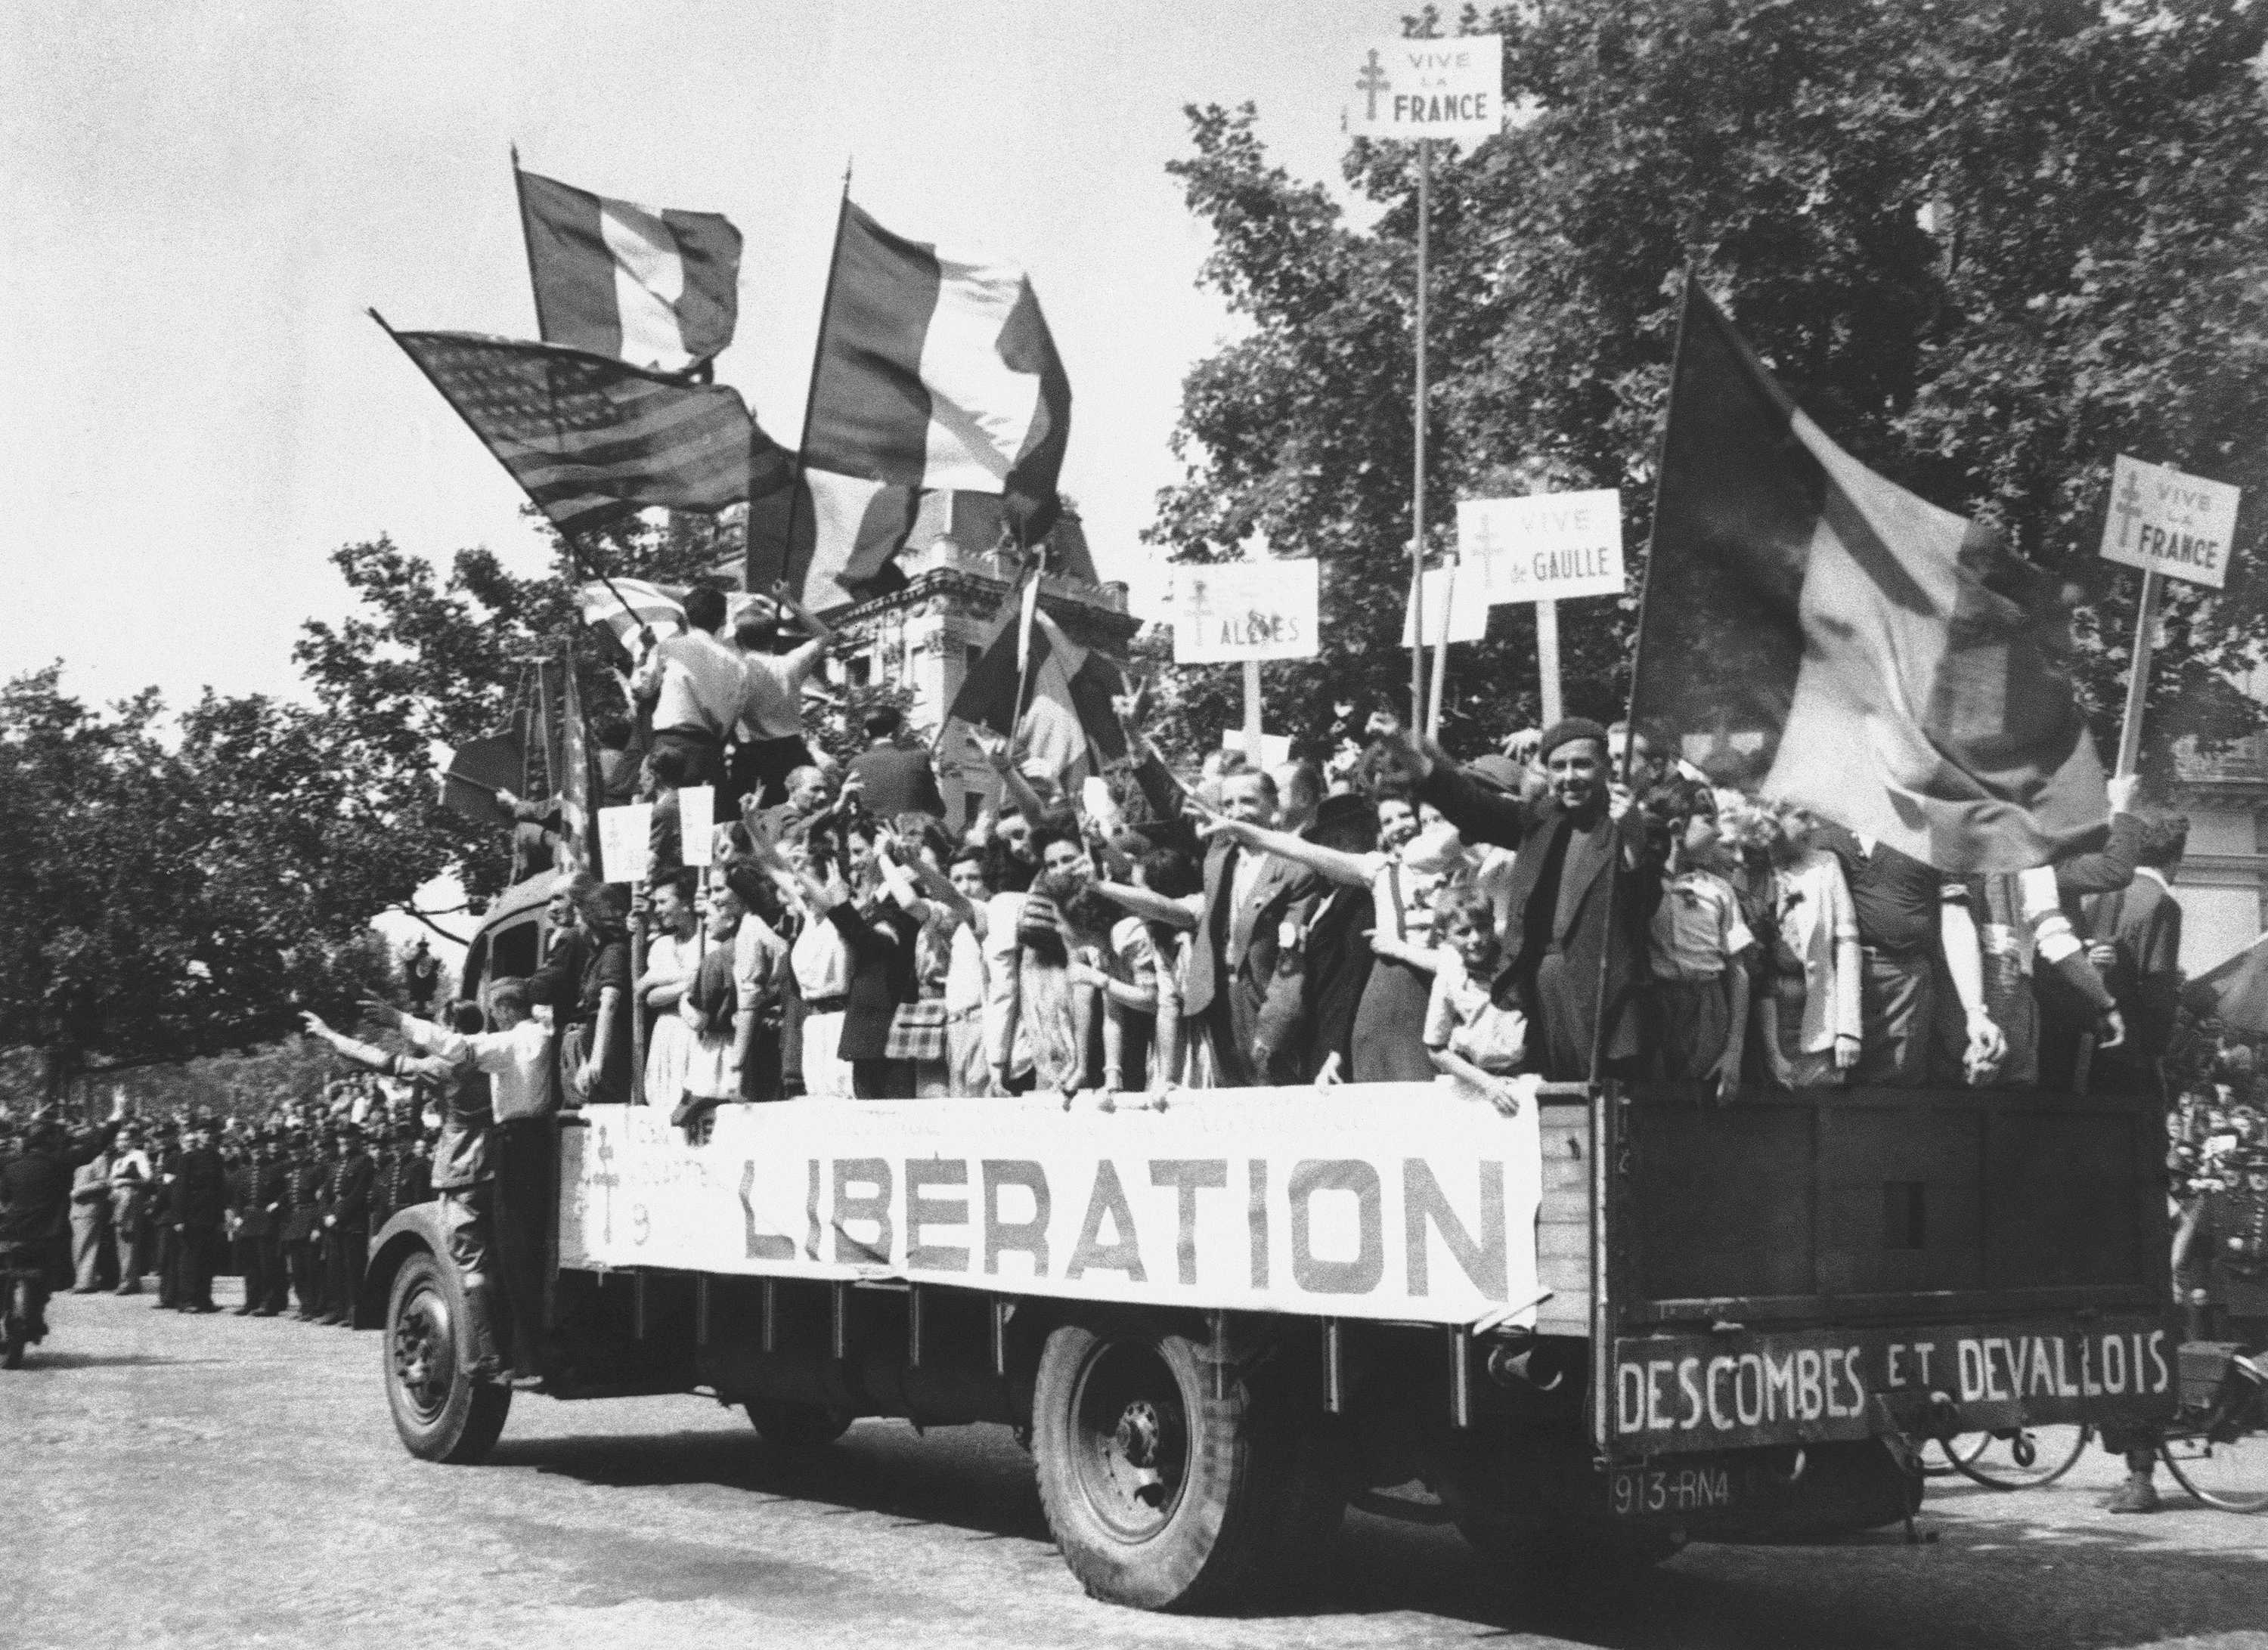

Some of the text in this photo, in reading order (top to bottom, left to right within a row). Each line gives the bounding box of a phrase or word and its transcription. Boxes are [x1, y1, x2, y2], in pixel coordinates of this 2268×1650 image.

[1408, 52, 1471, 69] VIVE
[1393, 91, 1488, 122] FRANCE
[2156, 481, 2211, 512] VIVE
[1520, 508, 1590, 533] VIVE
[2138, 522, 2219, 569] FRANCE
[1532, 546, 1610, 581] GAULLE
[739, 1156, 1509, 1302] LIBERATION
[1617, 1330, 2168, 1435] DESCOMBES ET DEVALLOIS
